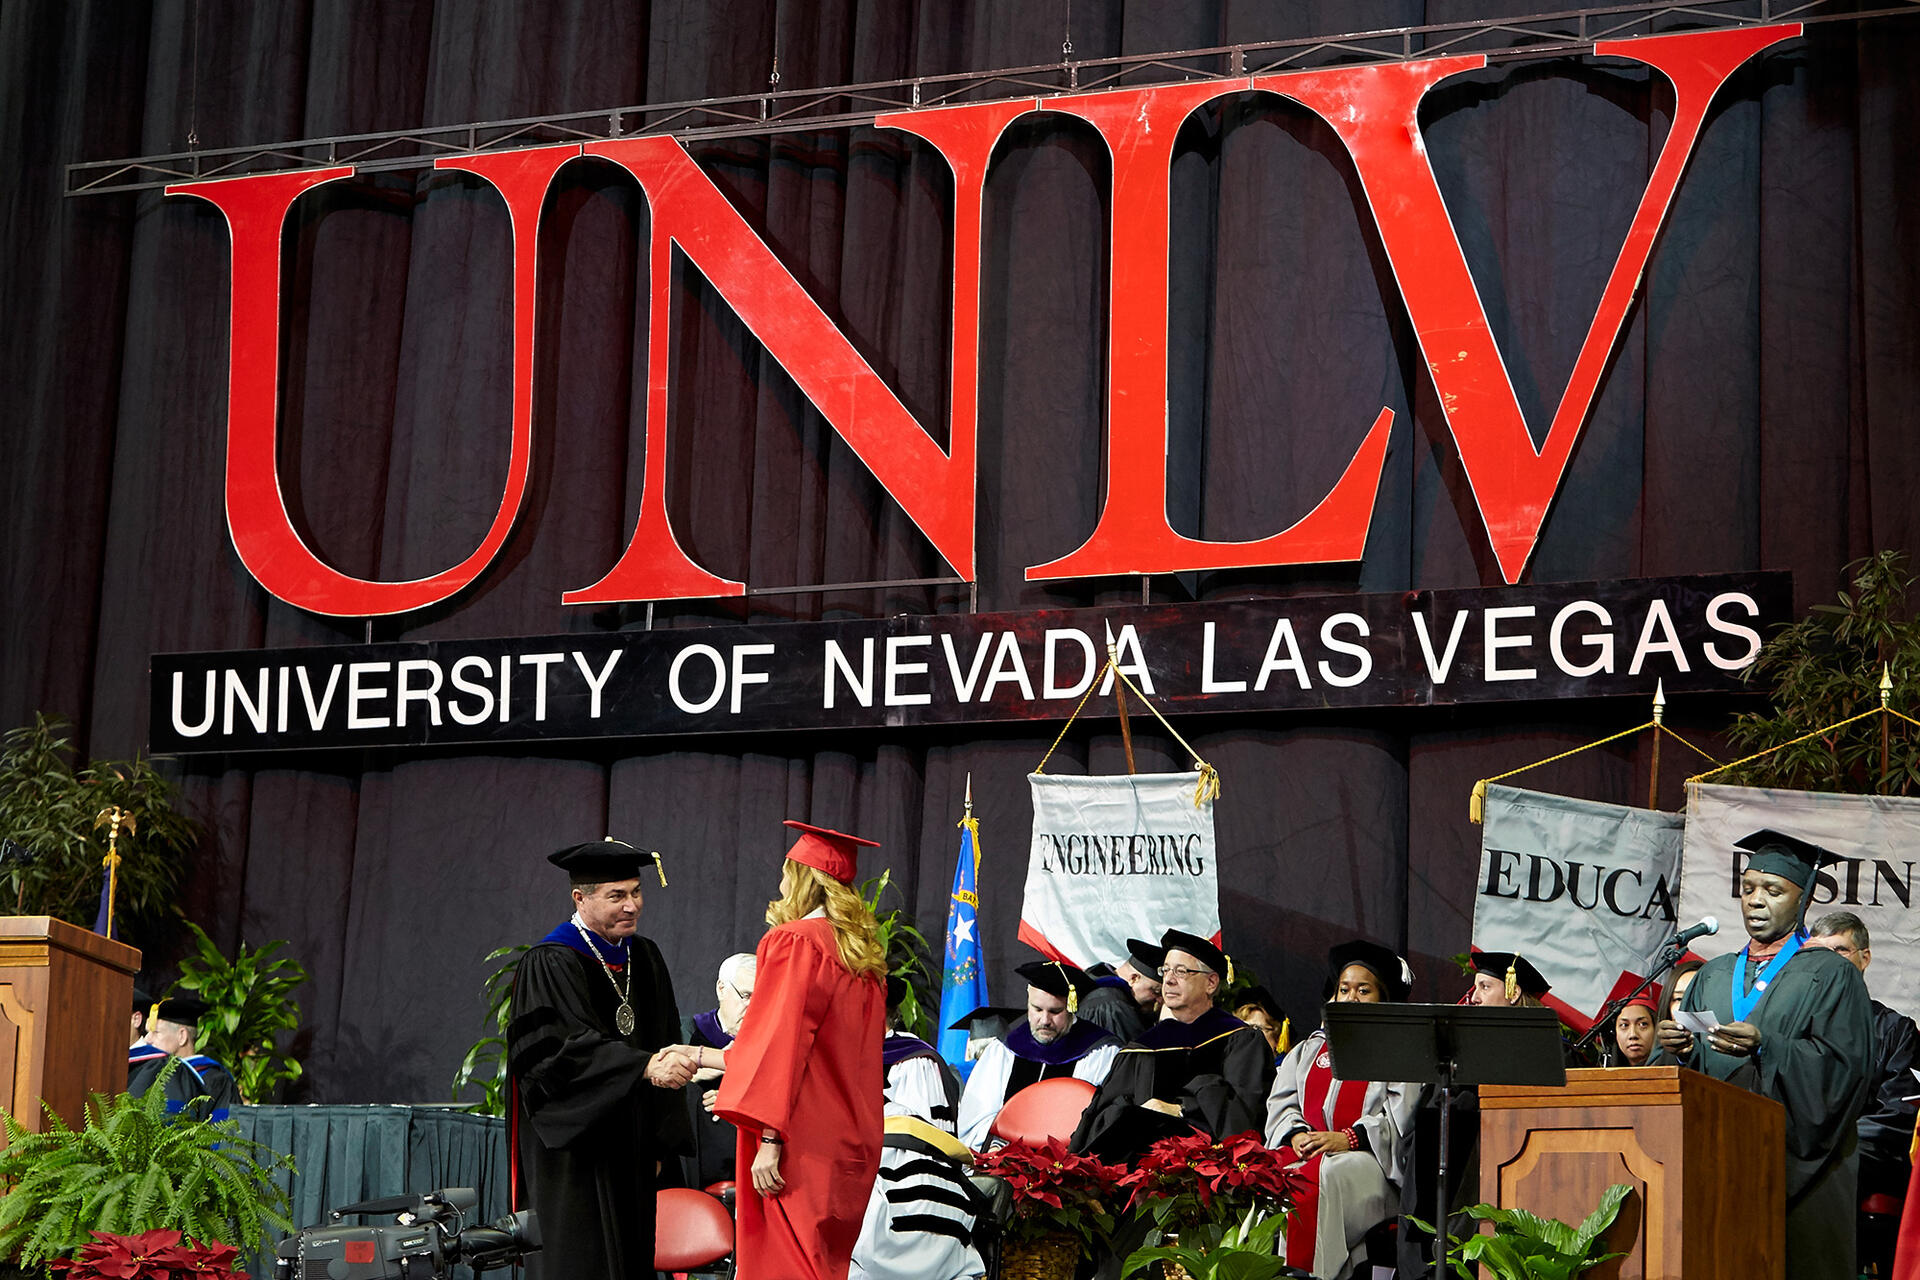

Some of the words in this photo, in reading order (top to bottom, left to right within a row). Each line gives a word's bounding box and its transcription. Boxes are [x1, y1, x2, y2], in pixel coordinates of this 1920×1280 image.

[163, 21, 1806, 619] UNLV
[172, 649, 623, 737] UNIVERSITY
[668, 643, 776, 714] OF
[823, 624, 1157, 709] NEVADA
[1201, 612, 1373, 694] LAS
[1411, 592, 1763, 684] VEGAS
